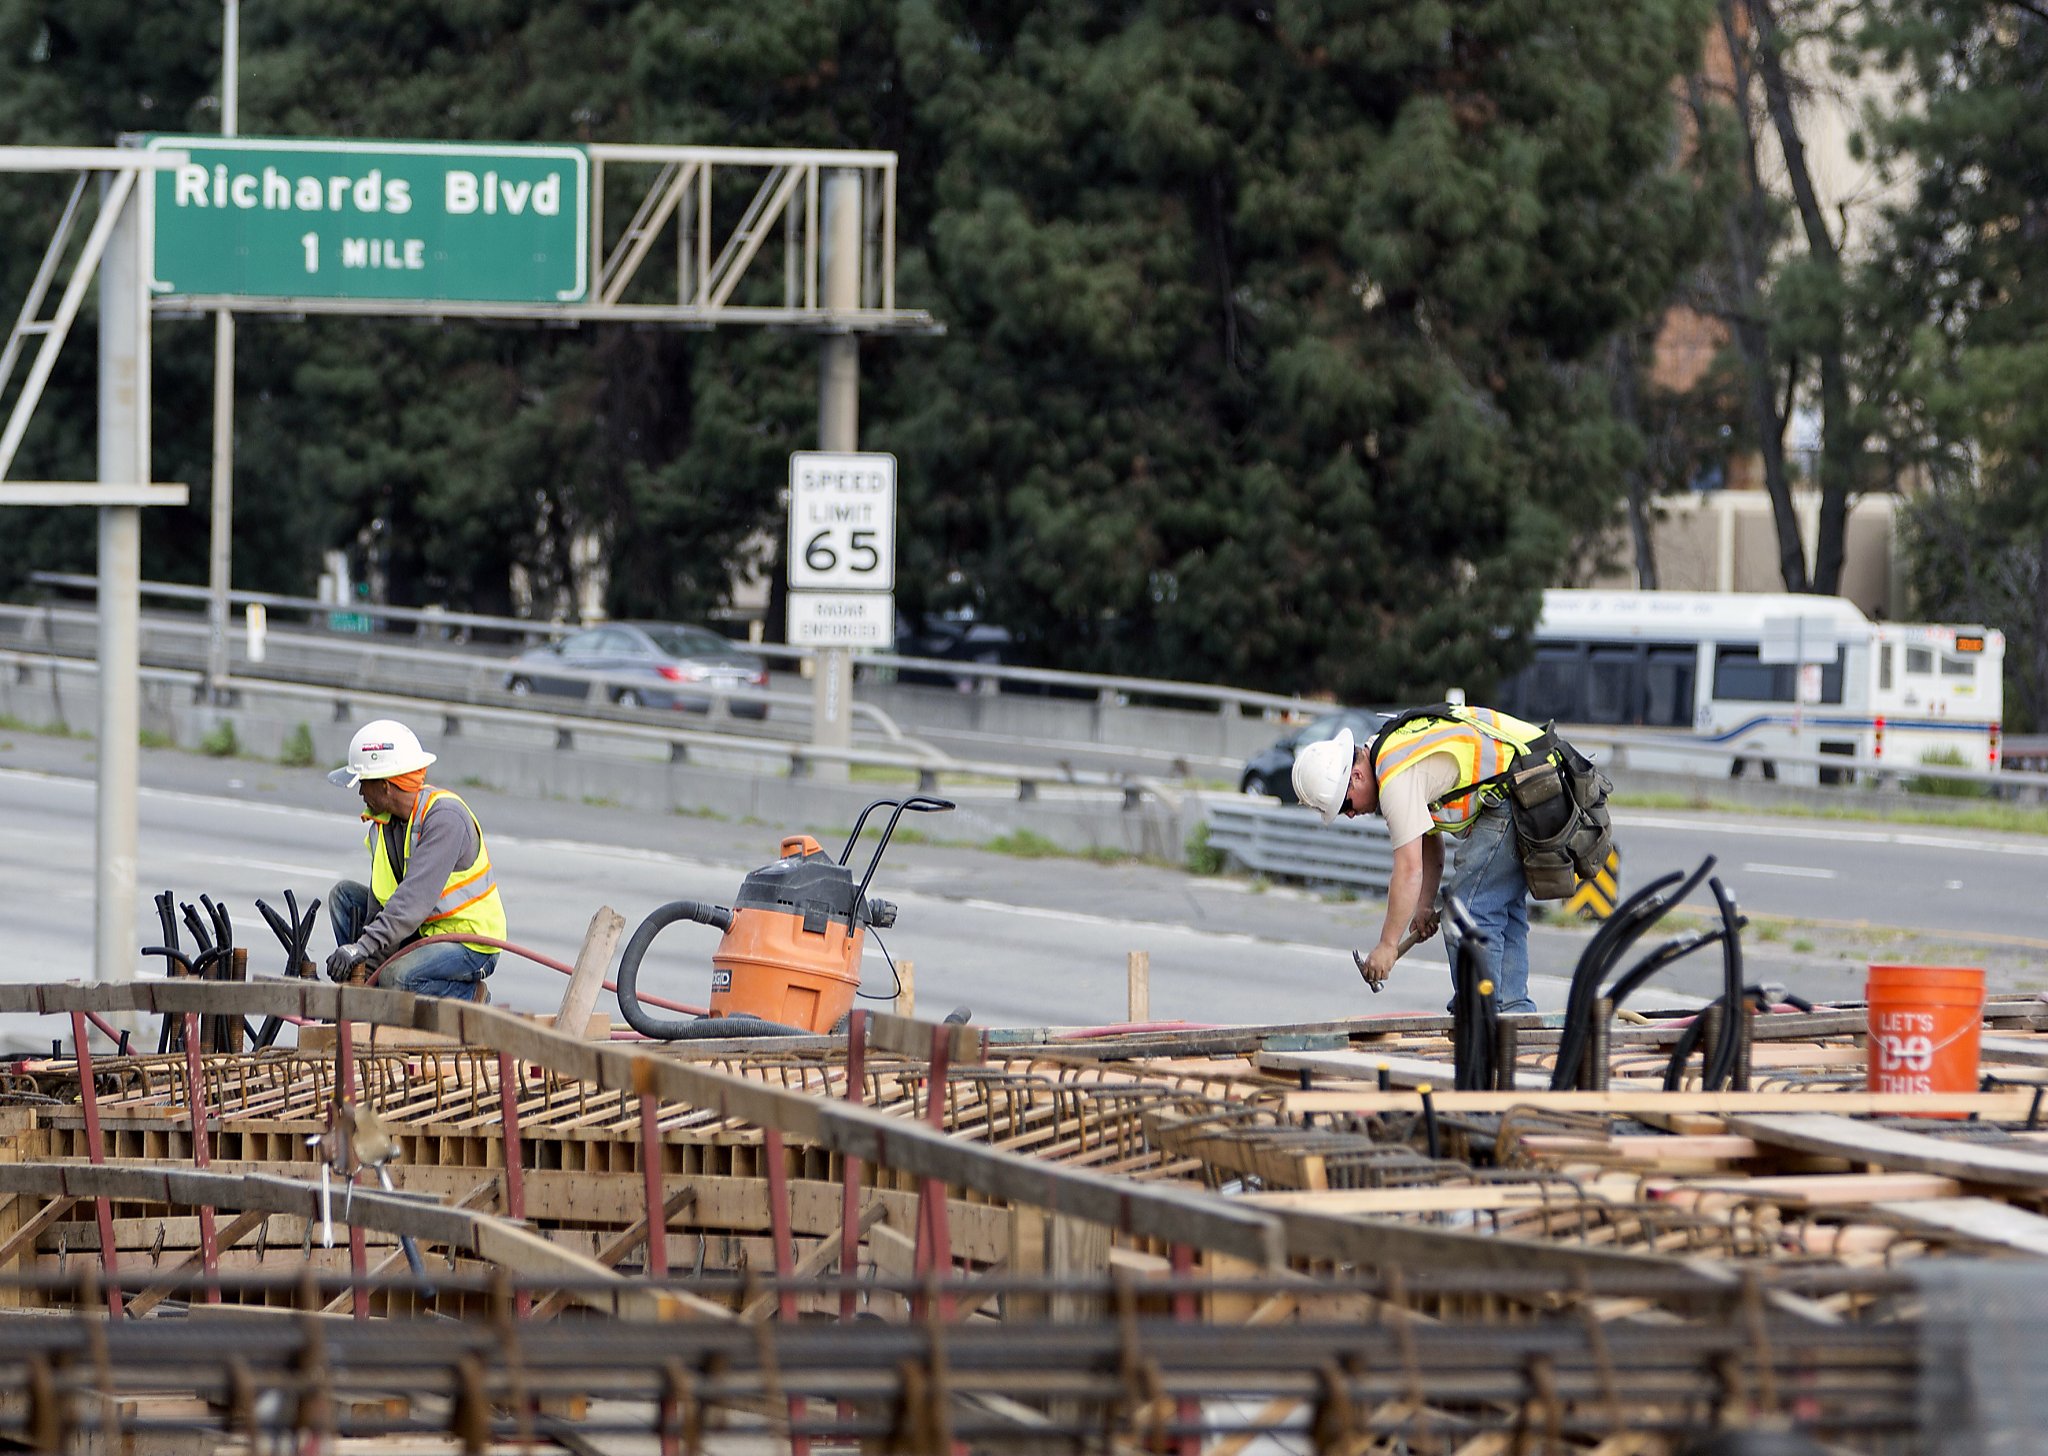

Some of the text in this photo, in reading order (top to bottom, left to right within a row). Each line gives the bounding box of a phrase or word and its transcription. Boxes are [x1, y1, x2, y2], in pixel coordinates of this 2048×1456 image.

[175, 163, 561, 216] Richards Blvd
[301, 231, 426, 273] 1 MILE
[802, 469, 886, 493] SPEED
[809, 502, 875, 523] LIMIT
[804, 529, 879, 573] 65
[1880, 1012, 1934, 1033] LET'S
[1879, 1034, 1933, 1072] DO
[1879, 1073, 1932, 1094] THIS
